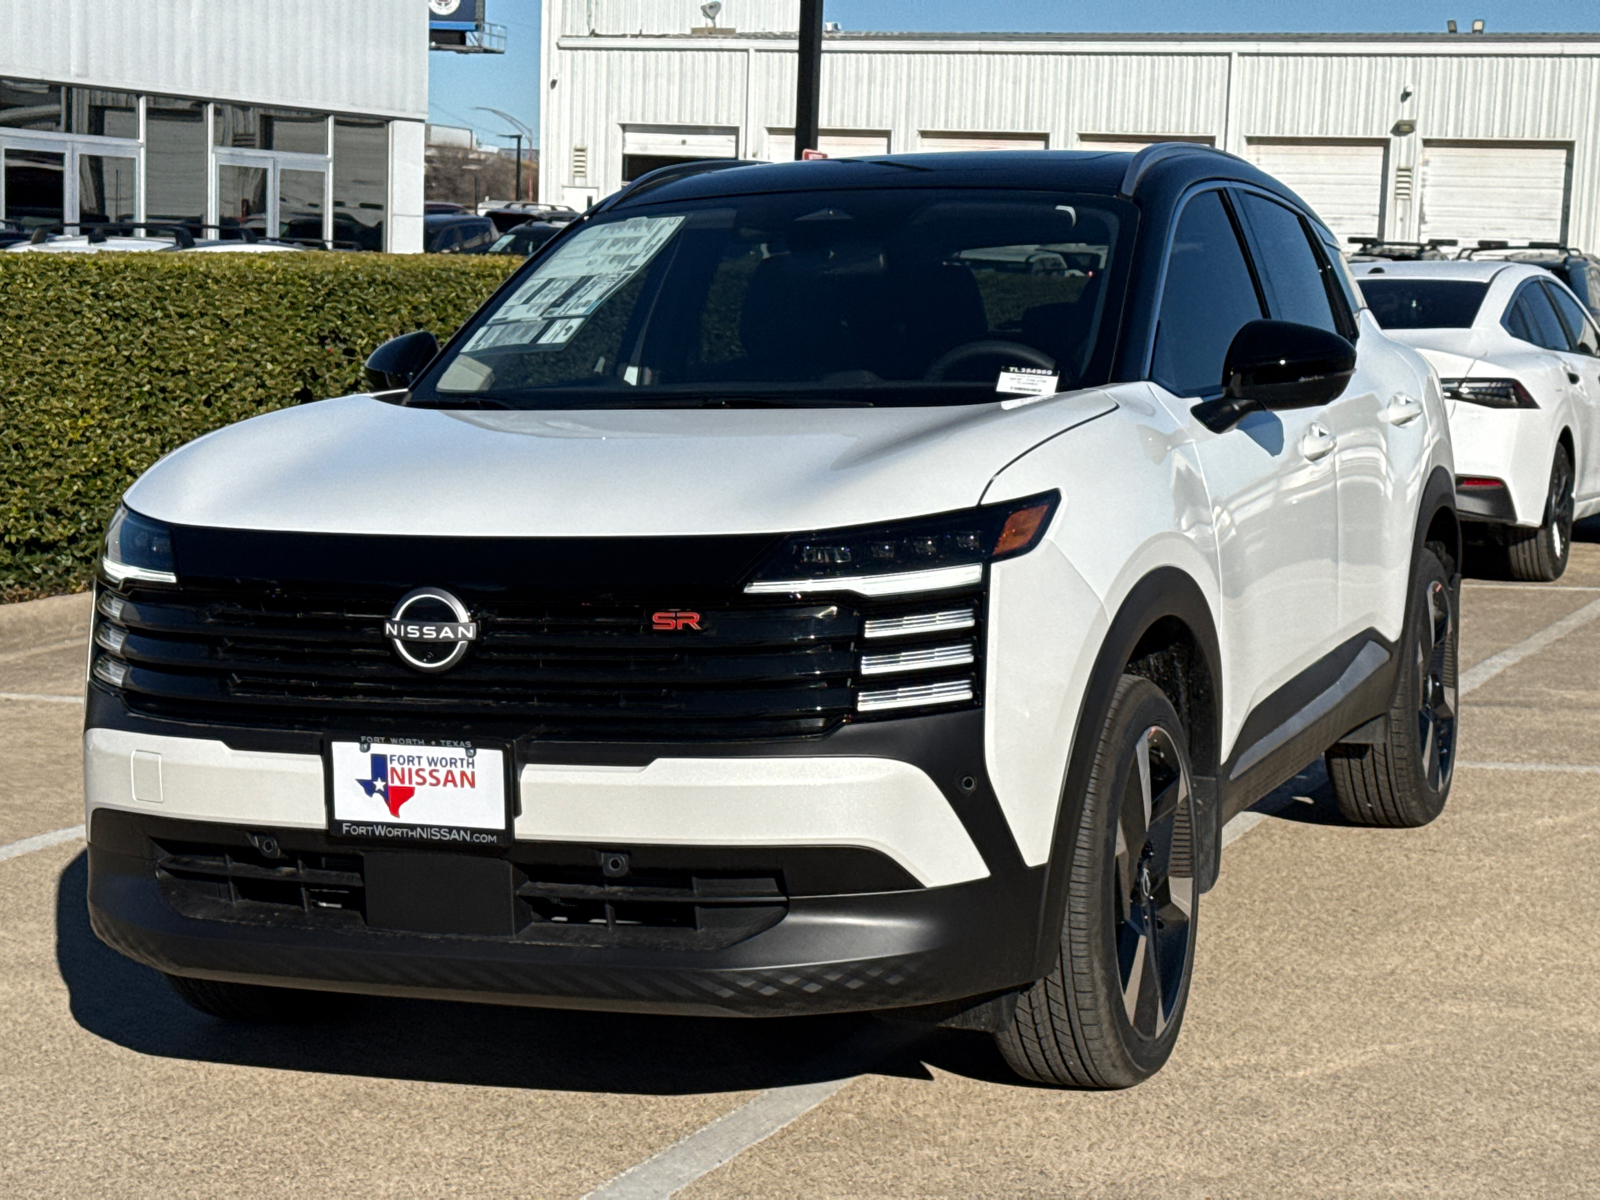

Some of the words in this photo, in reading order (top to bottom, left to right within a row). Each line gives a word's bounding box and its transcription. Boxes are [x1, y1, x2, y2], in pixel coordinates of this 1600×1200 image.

[652, 612, 701, 630] SR
[385, 622, 473, 639] NISSAN
[360, 735, 385, 743] FORT
[390, 737, 425, 745] WORTH
[440, 739, 472, 748] TEXAS
[389, 754, 423, 766] FORT
[427, 756, 475, 769] WORTH
[390, 766, 475, 789] NISSAN
